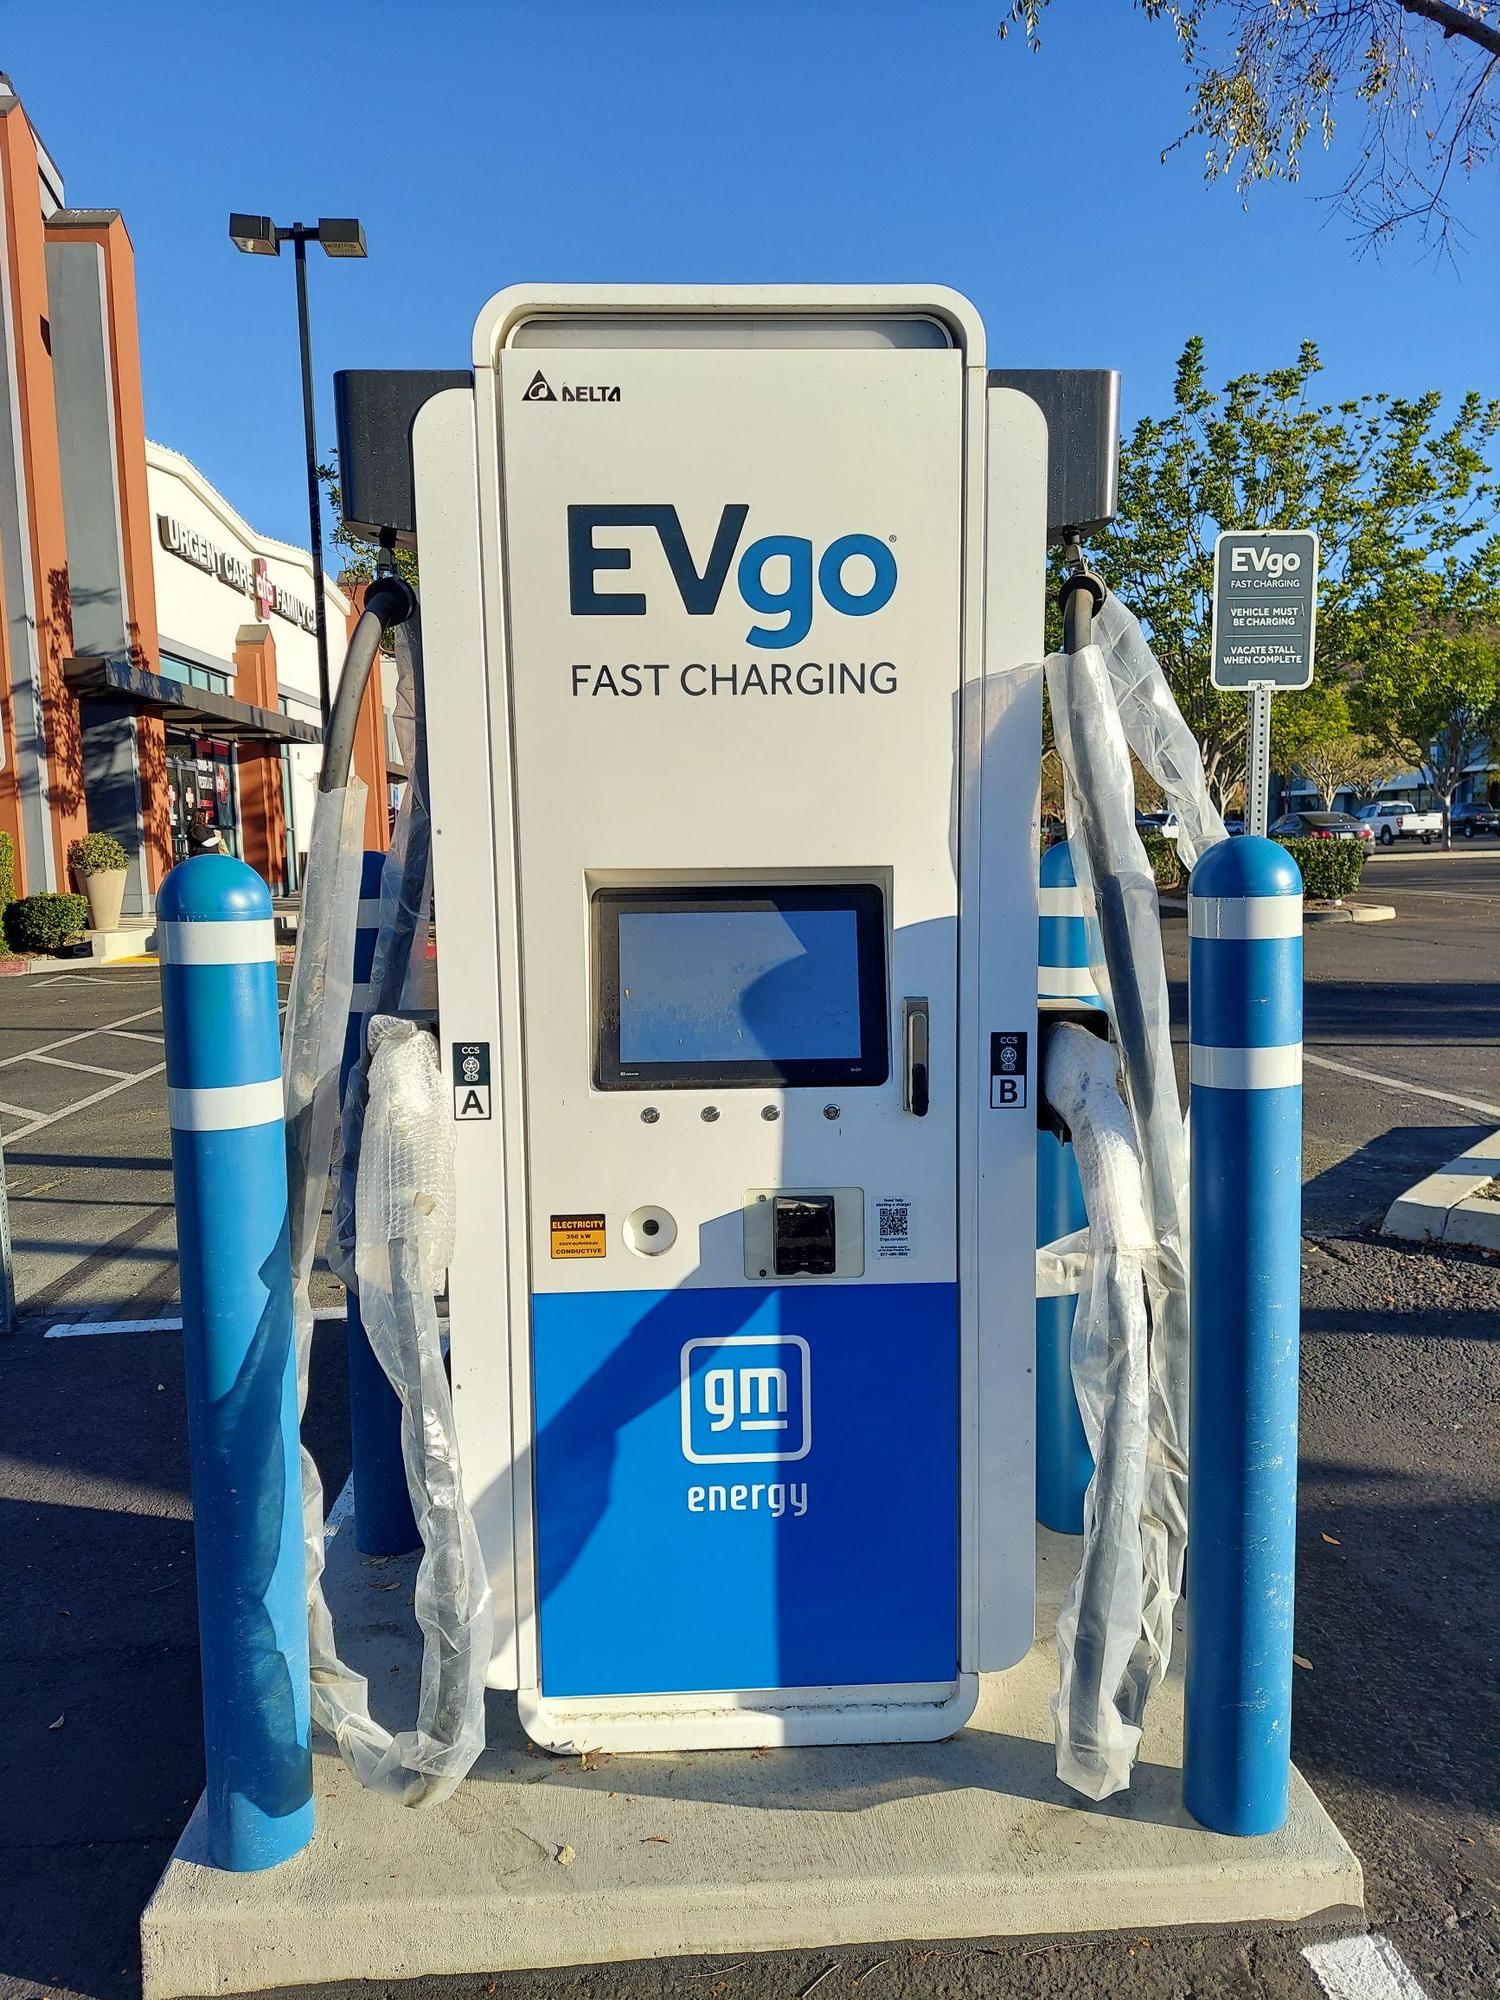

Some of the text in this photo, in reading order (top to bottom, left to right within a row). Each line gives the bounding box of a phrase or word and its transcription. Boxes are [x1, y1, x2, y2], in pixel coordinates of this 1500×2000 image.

[562, 386, 621, 402] DELTA
[163, 516, 223, 577] URGENT
[223, 552, 255, 593] CARE
[276, 586, 307, 625] FAMILY
[1231, 547, 1300, 578] EVgo
[567, 504, 898, 649] EVgo
[1231, 580, 1300, 588] FAST CHARGING
[1231, 607, 1298, 616] VEHICLE MUST
[1233, 617, 1295, 626] BE CHARGING
[1223, 655, 1302, 664] WHEN COMPLETE
[1231, 646, 1295, 654] VACATE STALL
[571, 662, 898, 697] FAST CHARGING
[461, 1046, 480, 1054] CCS
[1000, 1079, 1018, 1103] B
[461, 1089, 484, 1115] A
[552, 1220, 604, 1229] ELECTRICITY
[704, 1368, 788, 1432] gm
[687, 1483, 808, 1518] energy
